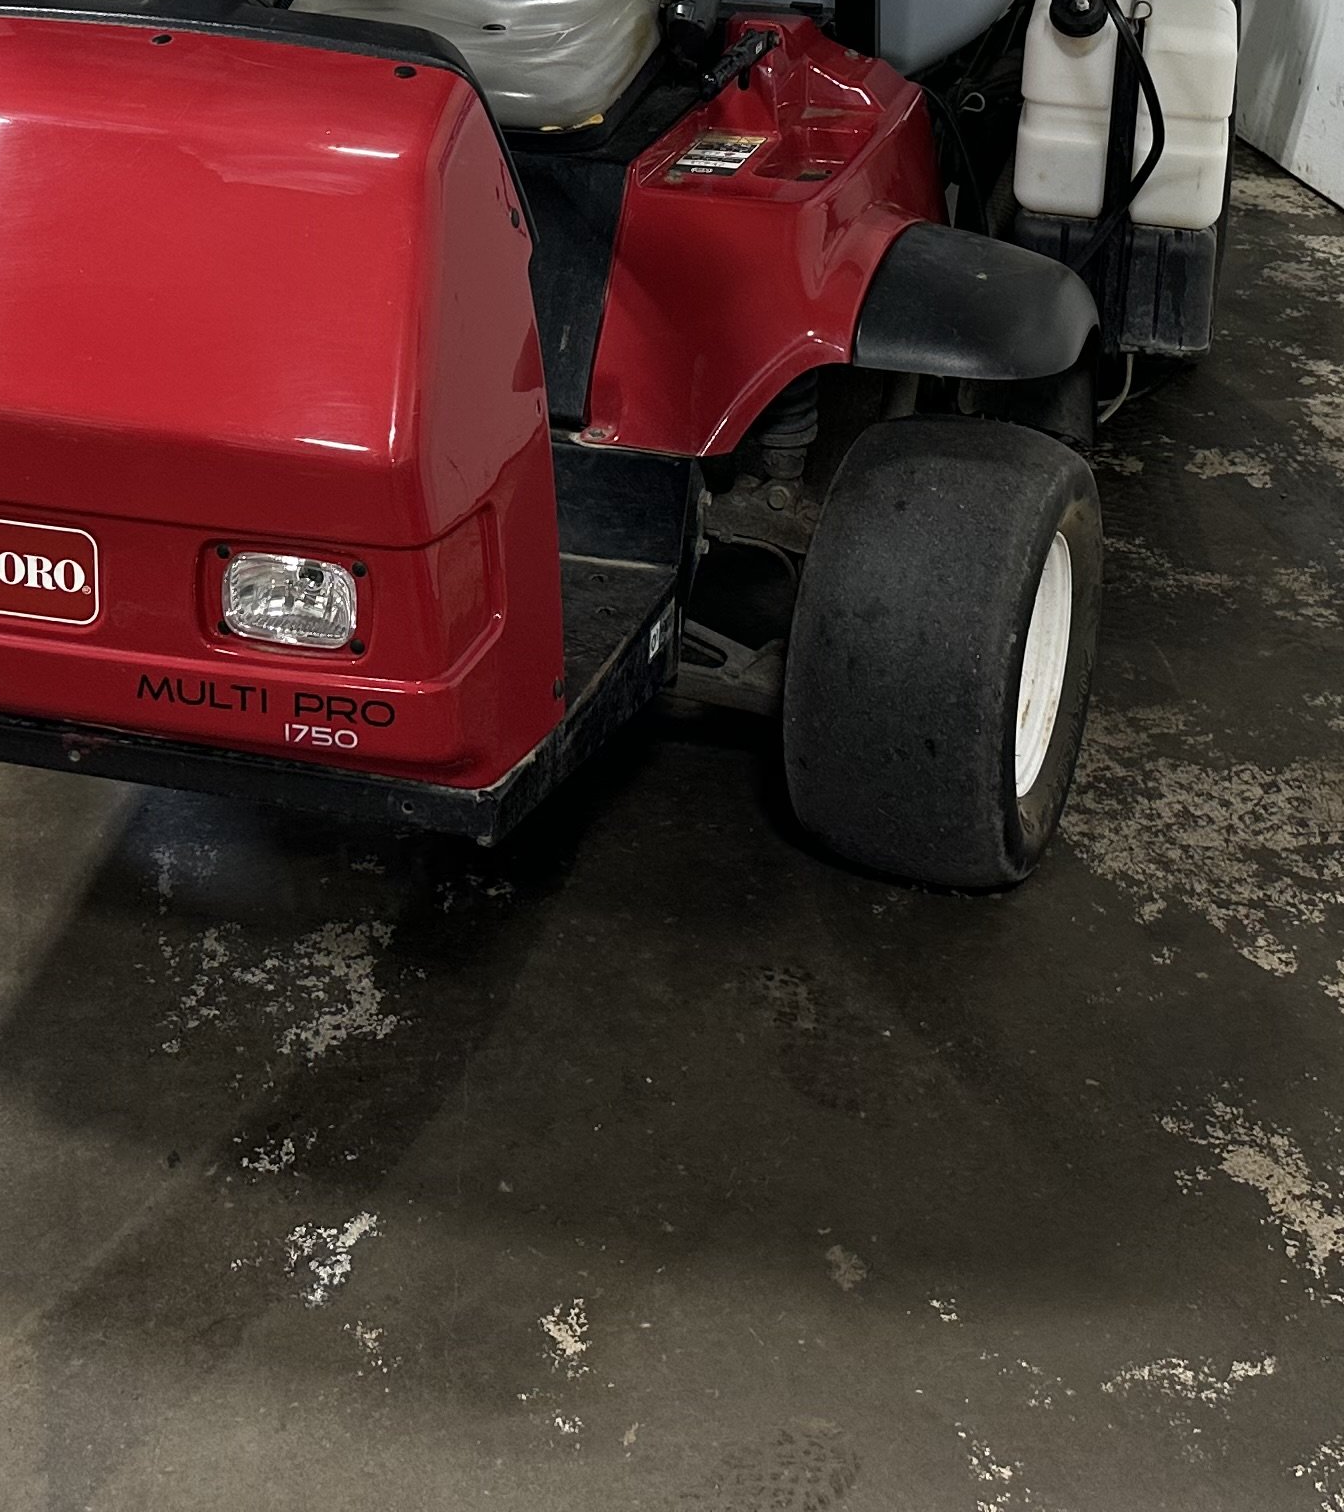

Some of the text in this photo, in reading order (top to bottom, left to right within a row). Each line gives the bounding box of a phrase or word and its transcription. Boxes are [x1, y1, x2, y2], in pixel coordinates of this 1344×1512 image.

[136, 674, 396, 728] MULTI PRO
[284, 723, 358, 749] 1750
